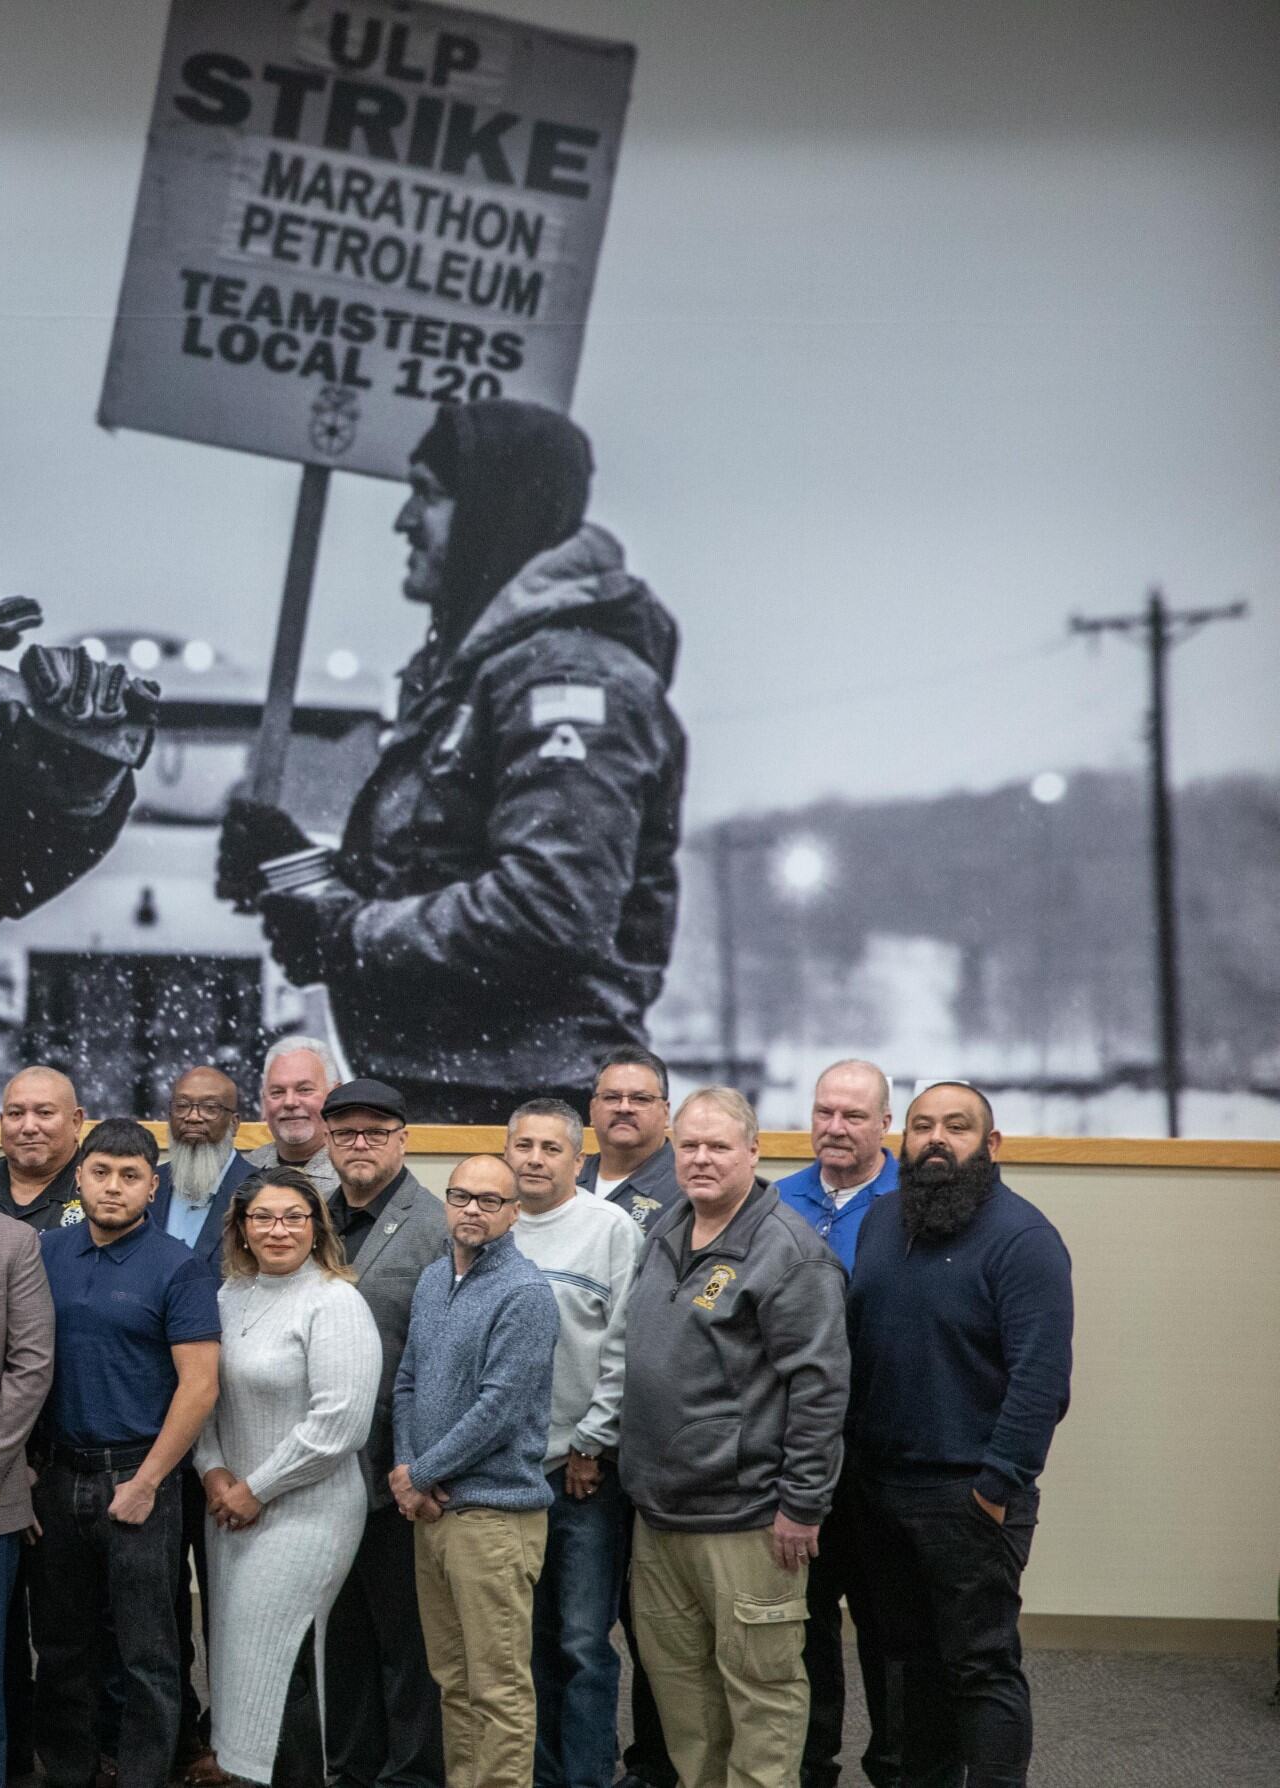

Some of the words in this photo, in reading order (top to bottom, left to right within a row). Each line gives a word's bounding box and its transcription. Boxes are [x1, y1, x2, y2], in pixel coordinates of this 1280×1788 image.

[326, 12, 482, 88] ULP
[172, 52, 600, 200] STRIKE
[260, 151, 545, 260] MARATHON
[238, 203, 544, 318] PETROLEUM
[179, 268, 525, 372] TEAMSTERS
[181, 315, 372, 389] LOCAL
[393, 358, 502, 402] 120
